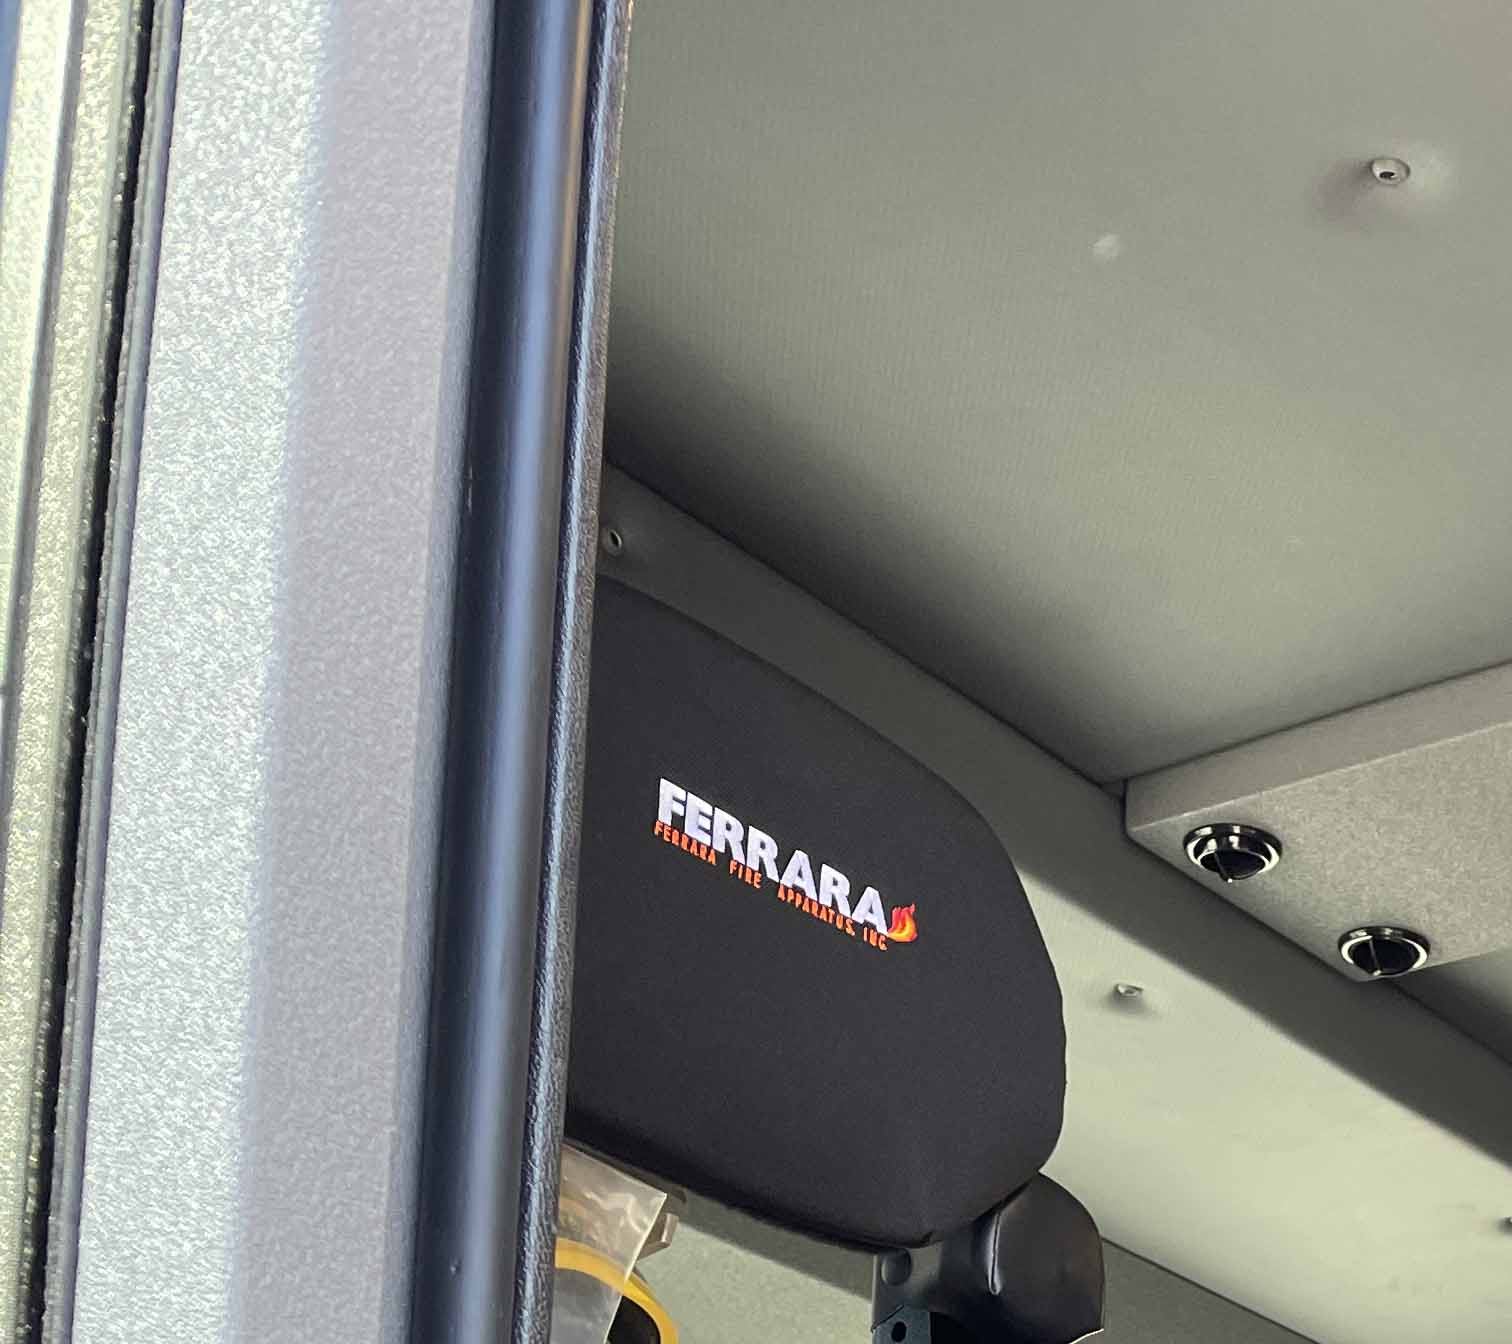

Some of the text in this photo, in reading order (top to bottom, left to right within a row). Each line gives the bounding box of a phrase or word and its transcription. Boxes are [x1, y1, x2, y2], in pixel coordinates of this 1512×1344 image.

[654, 819, 717, 866] FERRARA
[728, 859, 763, 889] FIRE
[658, 777, 889, 938] FERRARA
